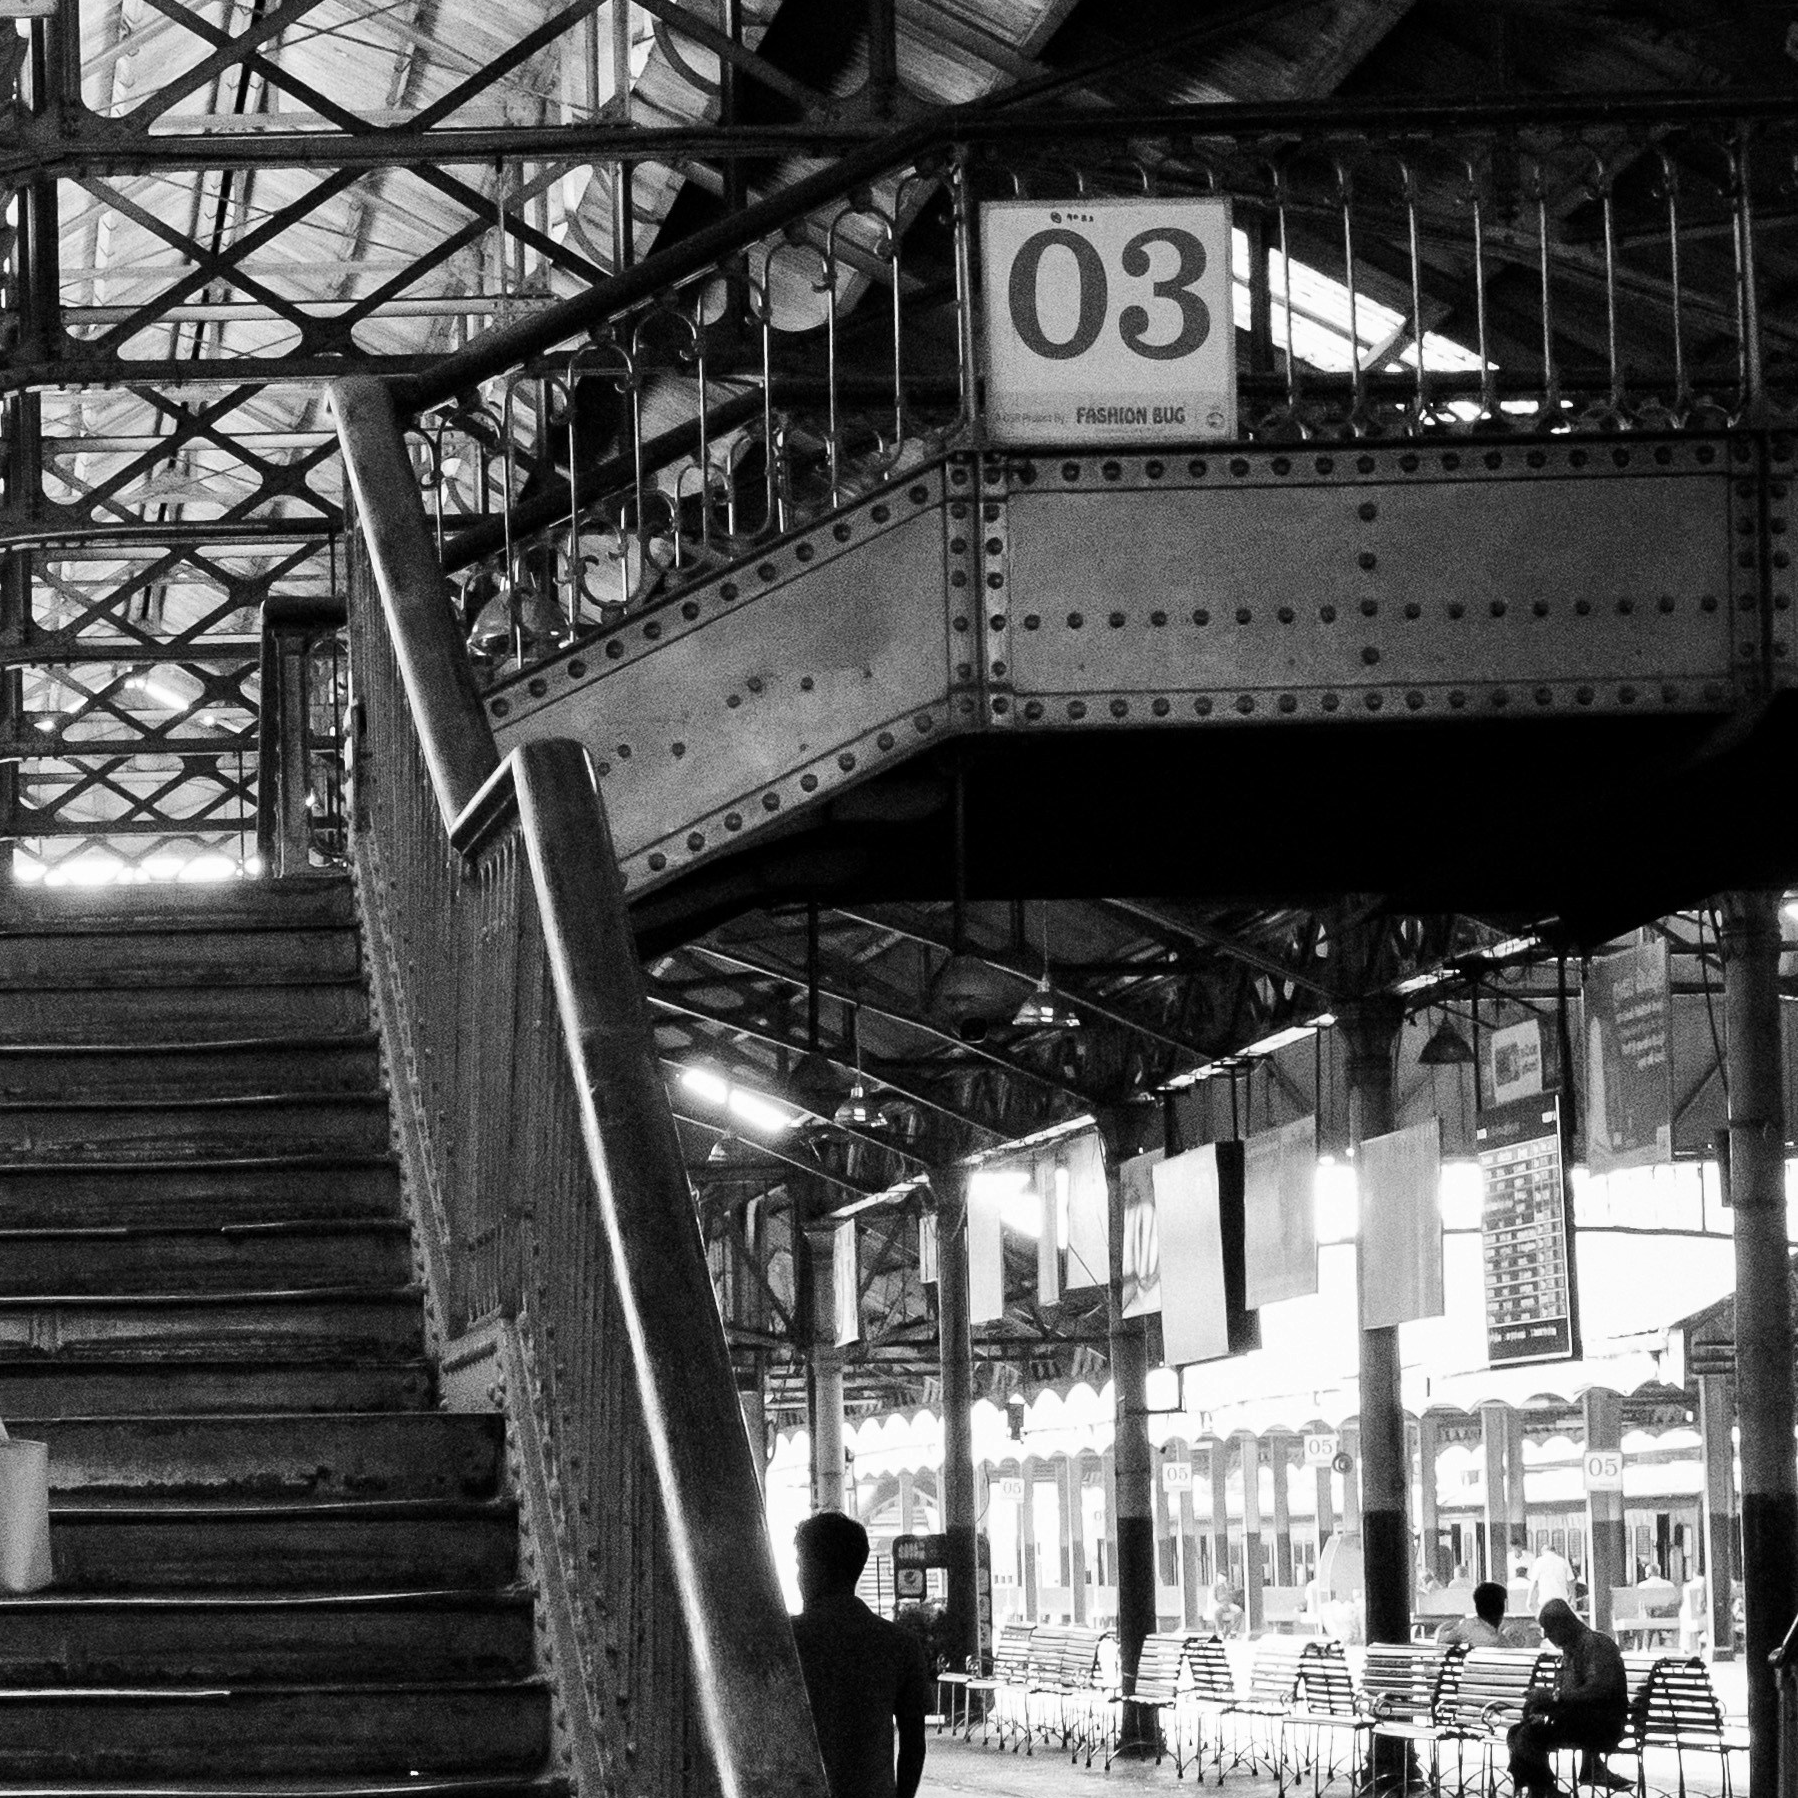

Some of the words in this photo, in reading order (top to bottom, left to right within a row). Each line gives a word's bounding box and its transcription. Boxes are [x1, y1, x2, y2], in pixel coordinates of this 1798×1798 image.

[1008, 227, 1211, 361] 03
[1076, 406, 1148, 425] FASHION
[1153, 406, 1186, 425] BUG
[1308, 1438, 1333, 1455] 05
[1166, 1466, 1189, 1482] 05
[1588, 1457, 1618, 1477] 05
[1002, 1481, 1023, 1496] 05
